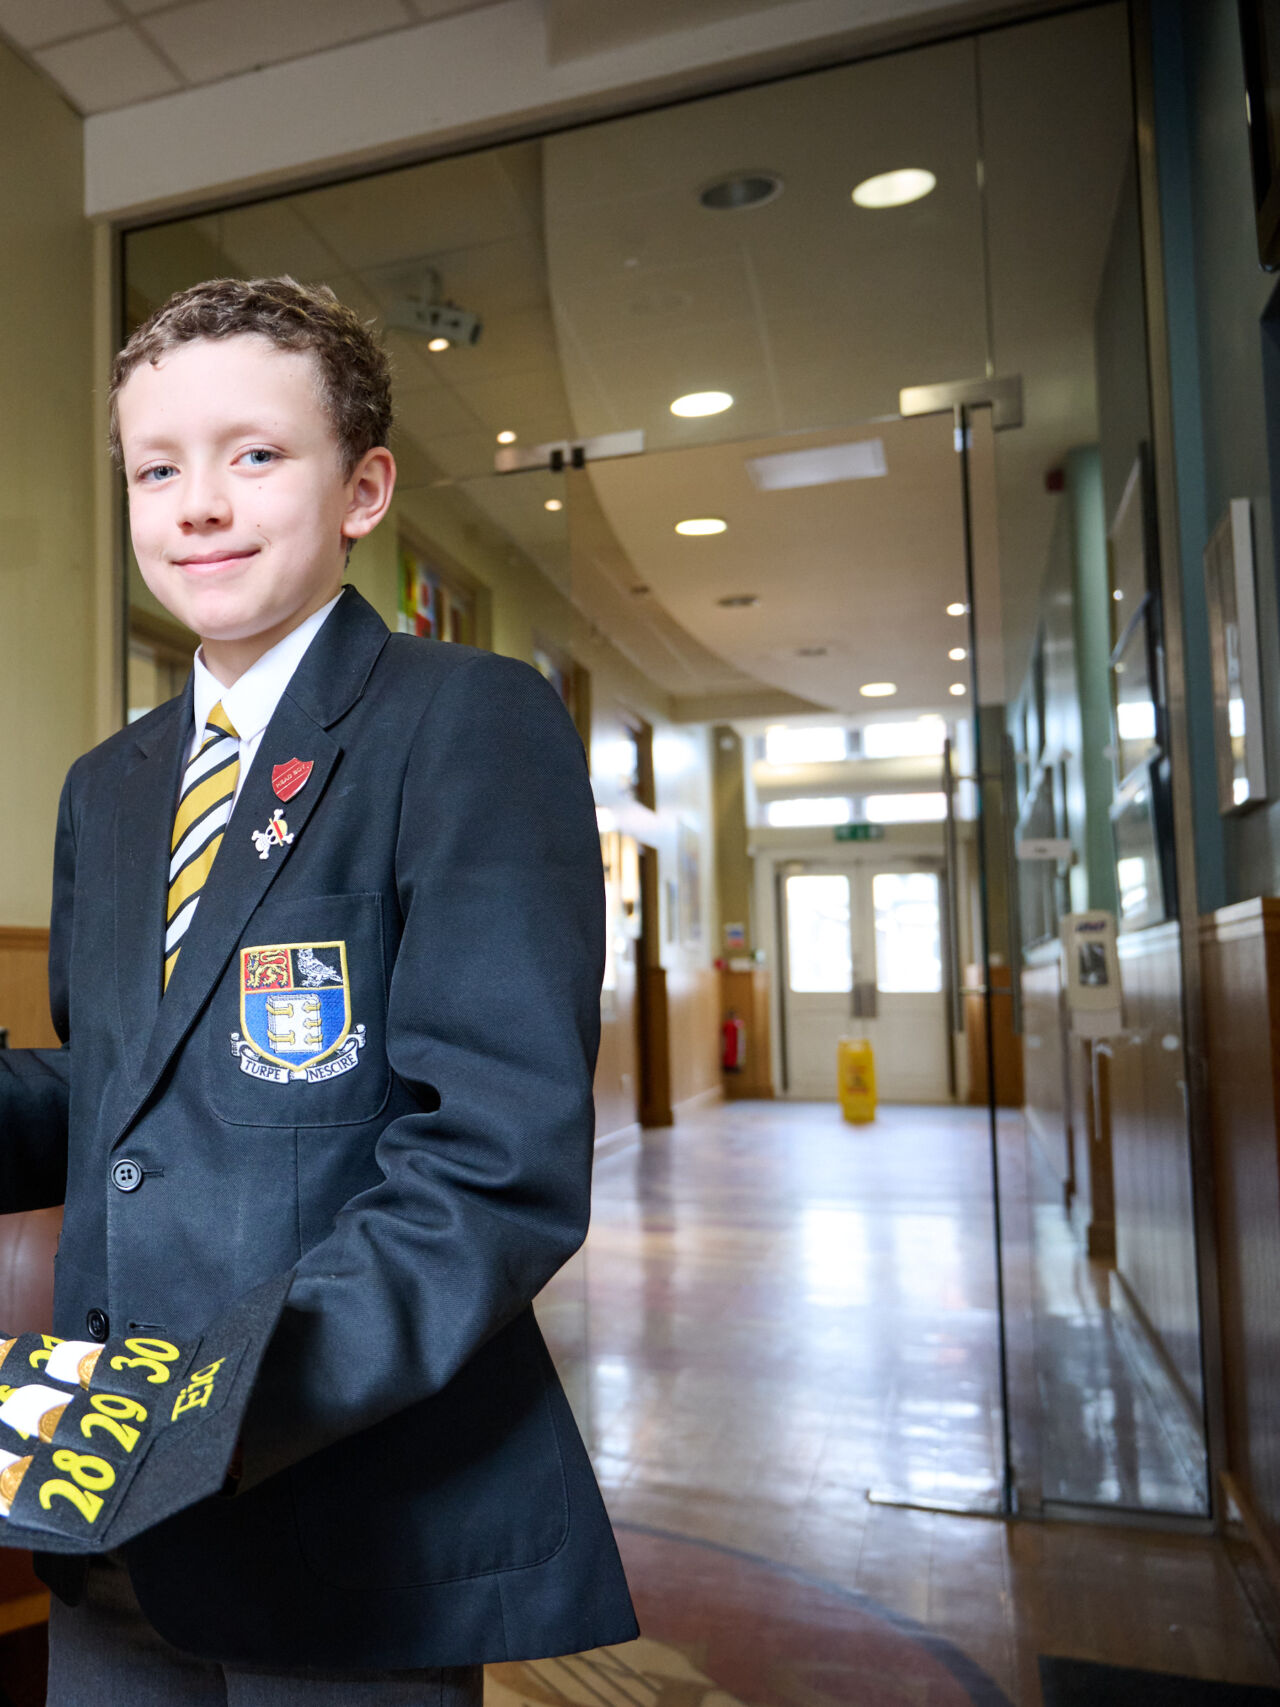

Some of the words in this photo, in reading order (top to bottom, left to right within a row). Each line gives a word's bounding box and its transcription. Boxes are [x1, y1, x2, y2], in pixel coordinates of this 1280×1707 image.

[245, 1059, 282, 1080] TURPE
[308, 1053, 357, 1080] NESCIRE
[111, 1337, 180, 1384] 30
[171, 1357, 226, 1422] Eid
[80, 1394, 148, 1453] 29
[39, 1449, 116, 1523] 28
